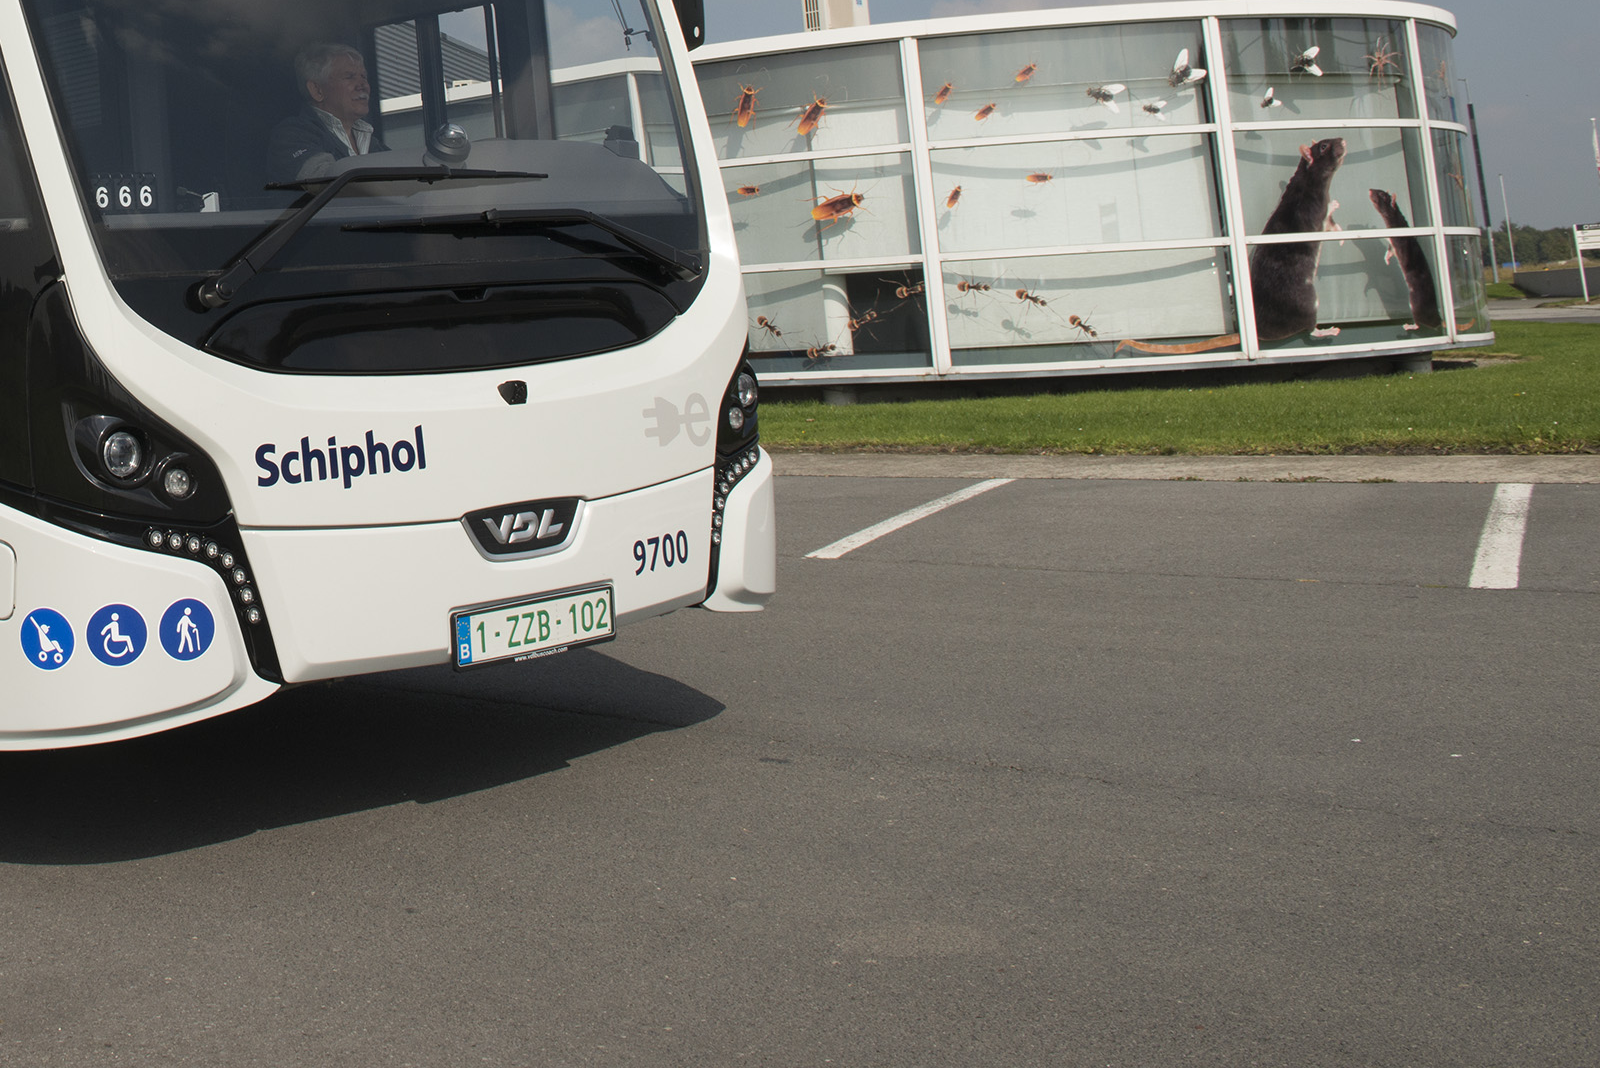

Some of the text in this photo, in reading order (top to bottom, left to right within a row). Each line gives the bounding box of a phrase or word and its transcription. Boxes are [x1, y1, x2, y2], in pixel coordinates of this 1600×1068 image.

[255, 424, 427, 489] Schiphol
[482, 509, 564, 544] VDL
[633, 530, 689, 576] 9700
[460, 643, 471, 659] B
